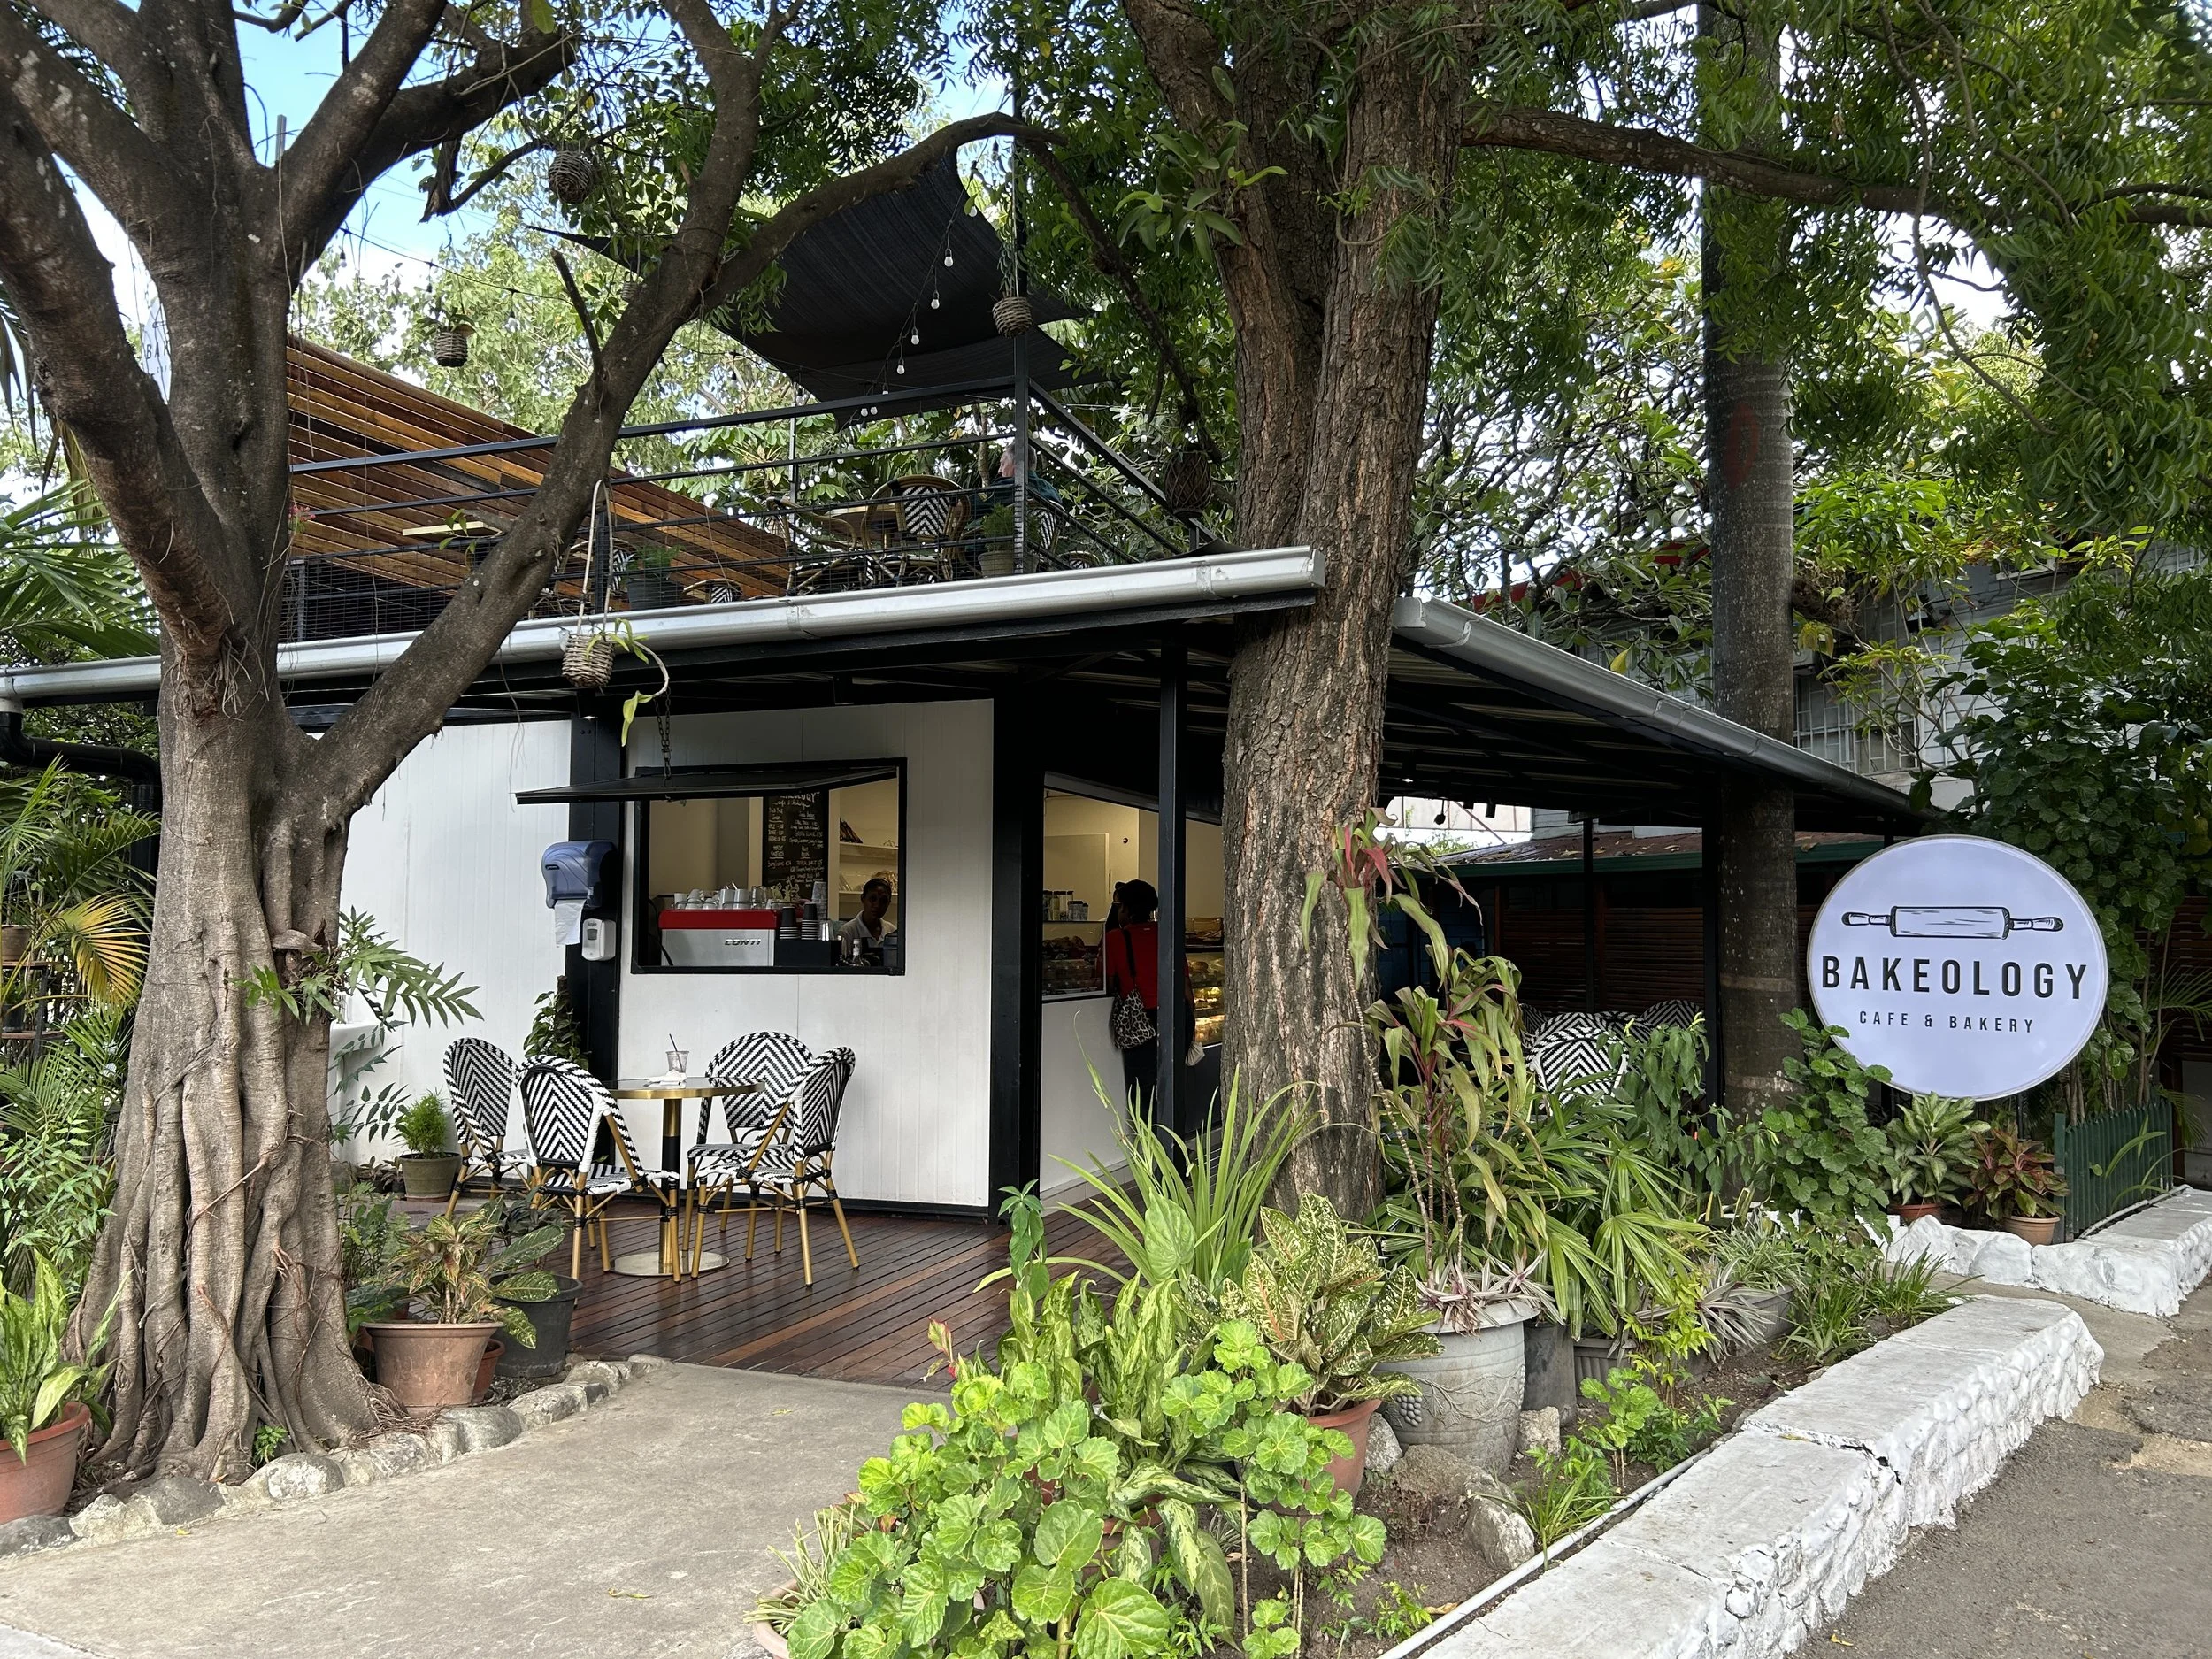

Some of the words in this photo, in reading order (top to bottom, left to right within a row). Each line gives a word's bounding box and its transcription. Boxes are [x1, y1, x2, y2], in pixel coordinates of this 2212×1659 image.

[1822, 955, 2087, 1000] BAKEOLOGY
[1859, 1010, 1909, 1026] CAFE
[1924, 1014, 1932, 1028] &
[1949, 1015, 2033, 1033] BAKERY
